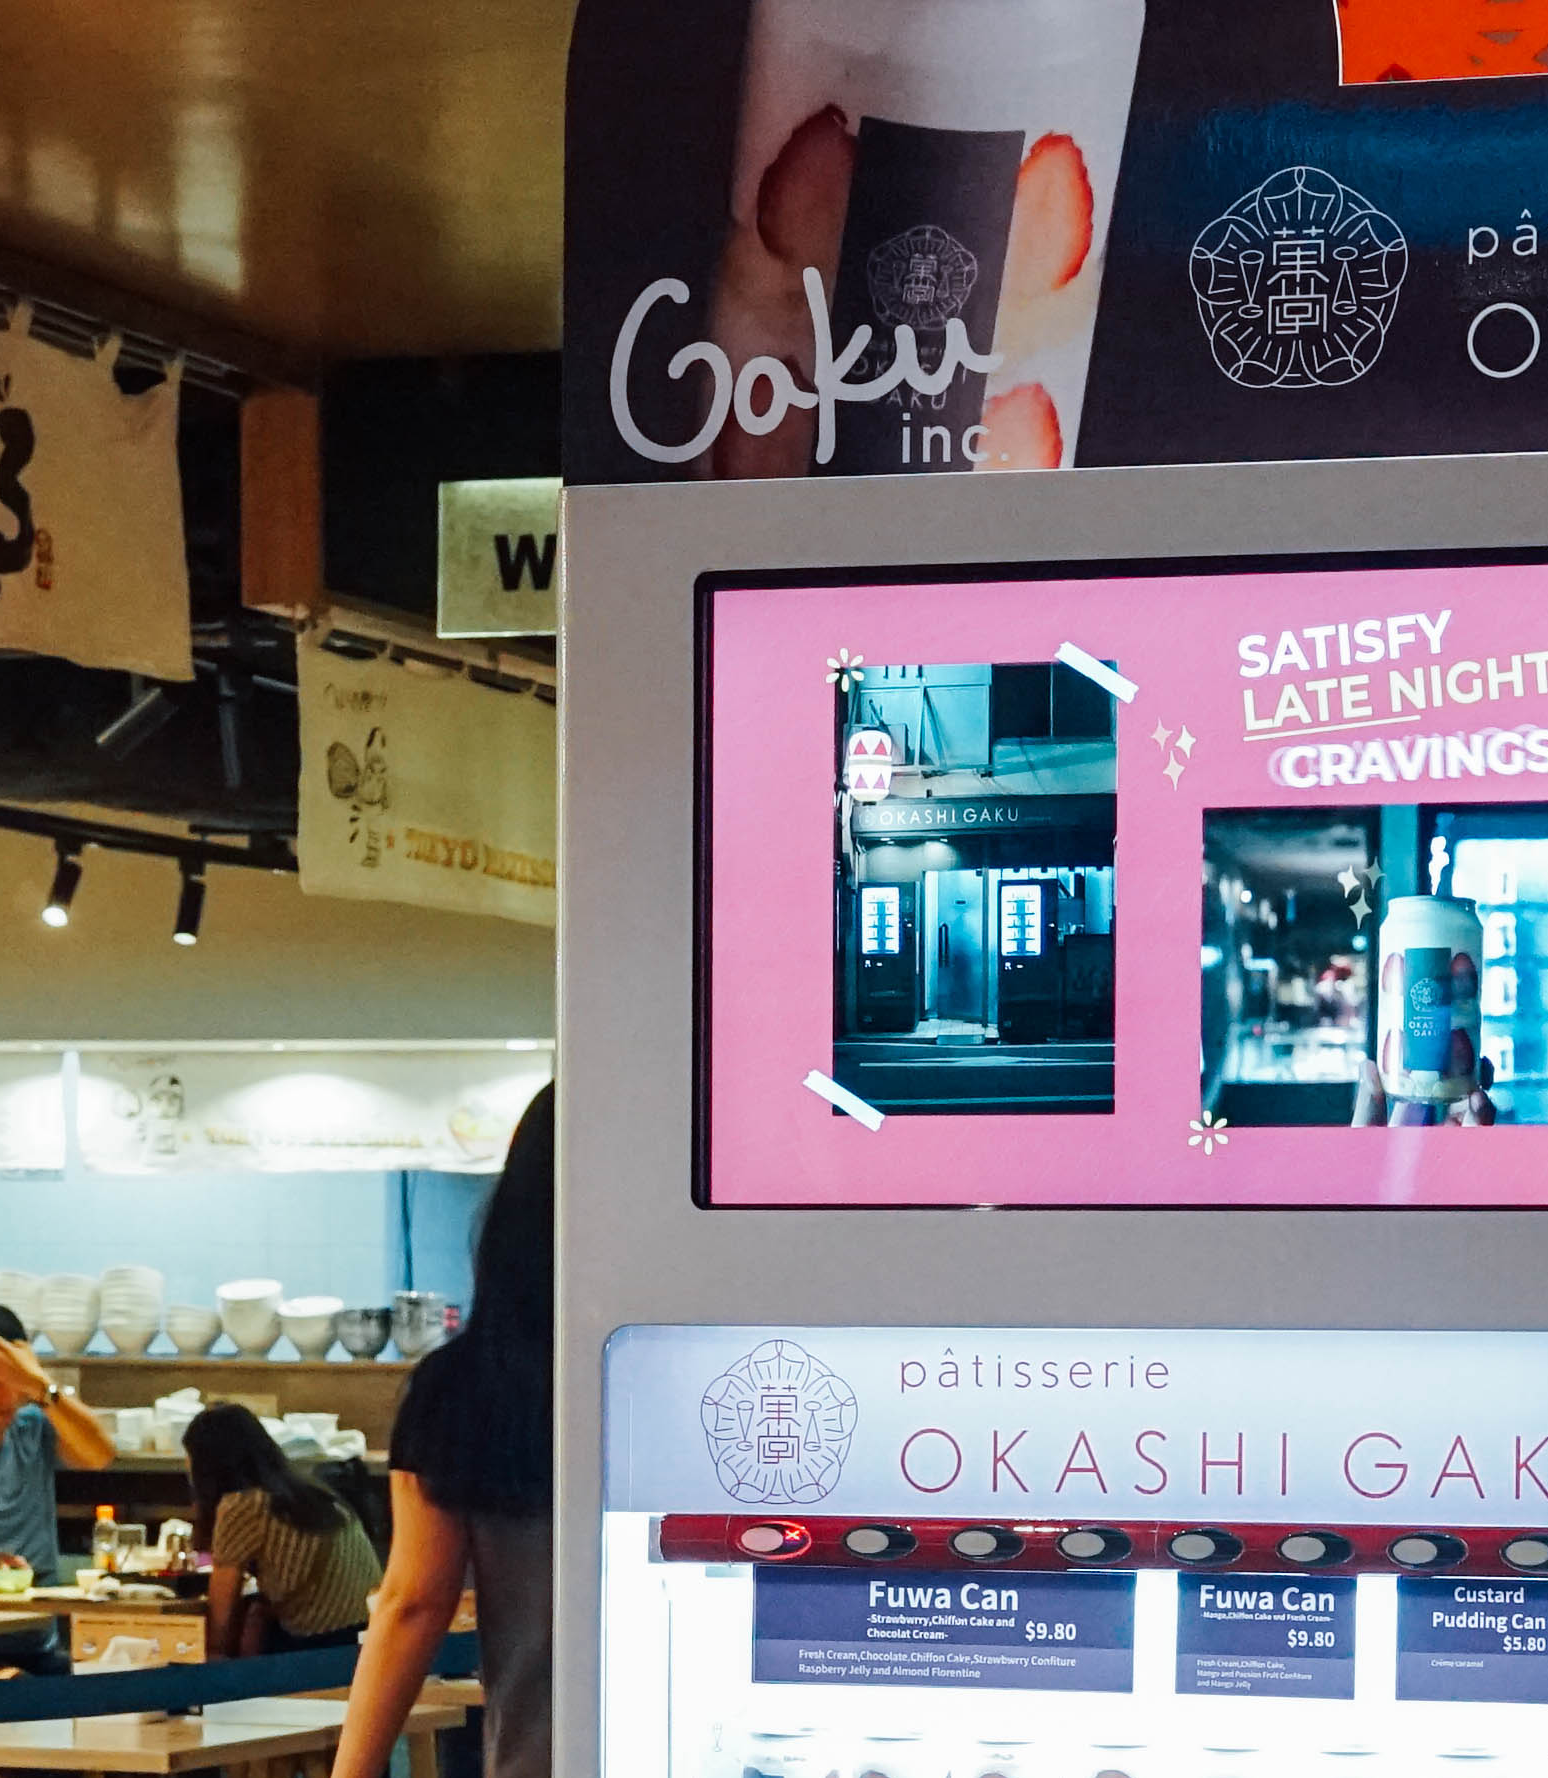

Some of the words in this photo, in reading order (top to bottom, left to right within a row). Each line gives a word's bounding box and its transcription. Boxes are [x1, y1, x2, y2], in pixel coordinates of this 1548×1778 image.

[609, 267, 1004, 465] Gaku
[901, 412, 1011, 463] inc.
[1237, 609, 1452, 678] SATISFY
[1243, 676, 1374, 732] LATE
[880, 807, 958, 827] OKASHI
[962, 805, 1020, 824] GAKU
[897, 1346, 1171, 1395] pâtisserie
[899, 1426, 1291, 1501] OKASHI
[868, 1580, 952, 1609] Fuwa
[960, 1582, 1019, 1611] Can
[1199, 1584, 1274, 1610] Fuwa
[1282, 1587, 1335, 1612] Can
[1454, 1585, 1525, 1605] Custard
[970, 1617, 994, 1626] Cake
[996, 1617, 1015, 1627] and
[1025, 1620, 1077, 1642] $9.80
[1432, 1611, 1507, 1633] Pudding
[1511, 1614, 1546, 1630] Can
[867, 1628, 910, 1639] Chocolat
[913, 1630, 948, 1640] Cream-
[1287, 1629, 1335, 1648] $9.80
[1503, 1634, 1547, 1653] $5.80
[799, 1649, 824, 1659] Fresh
[1030, 1656, 1076, 1666] Confiture
[798, 1663, 847, 1676] Raspberry
[849, 1664, 871, 1677] Jelly
[873, 1666, 891, 1676] and
[893, 1666, 929, 1676] Almond
[932, 1668, 981, 1678] Florentine
